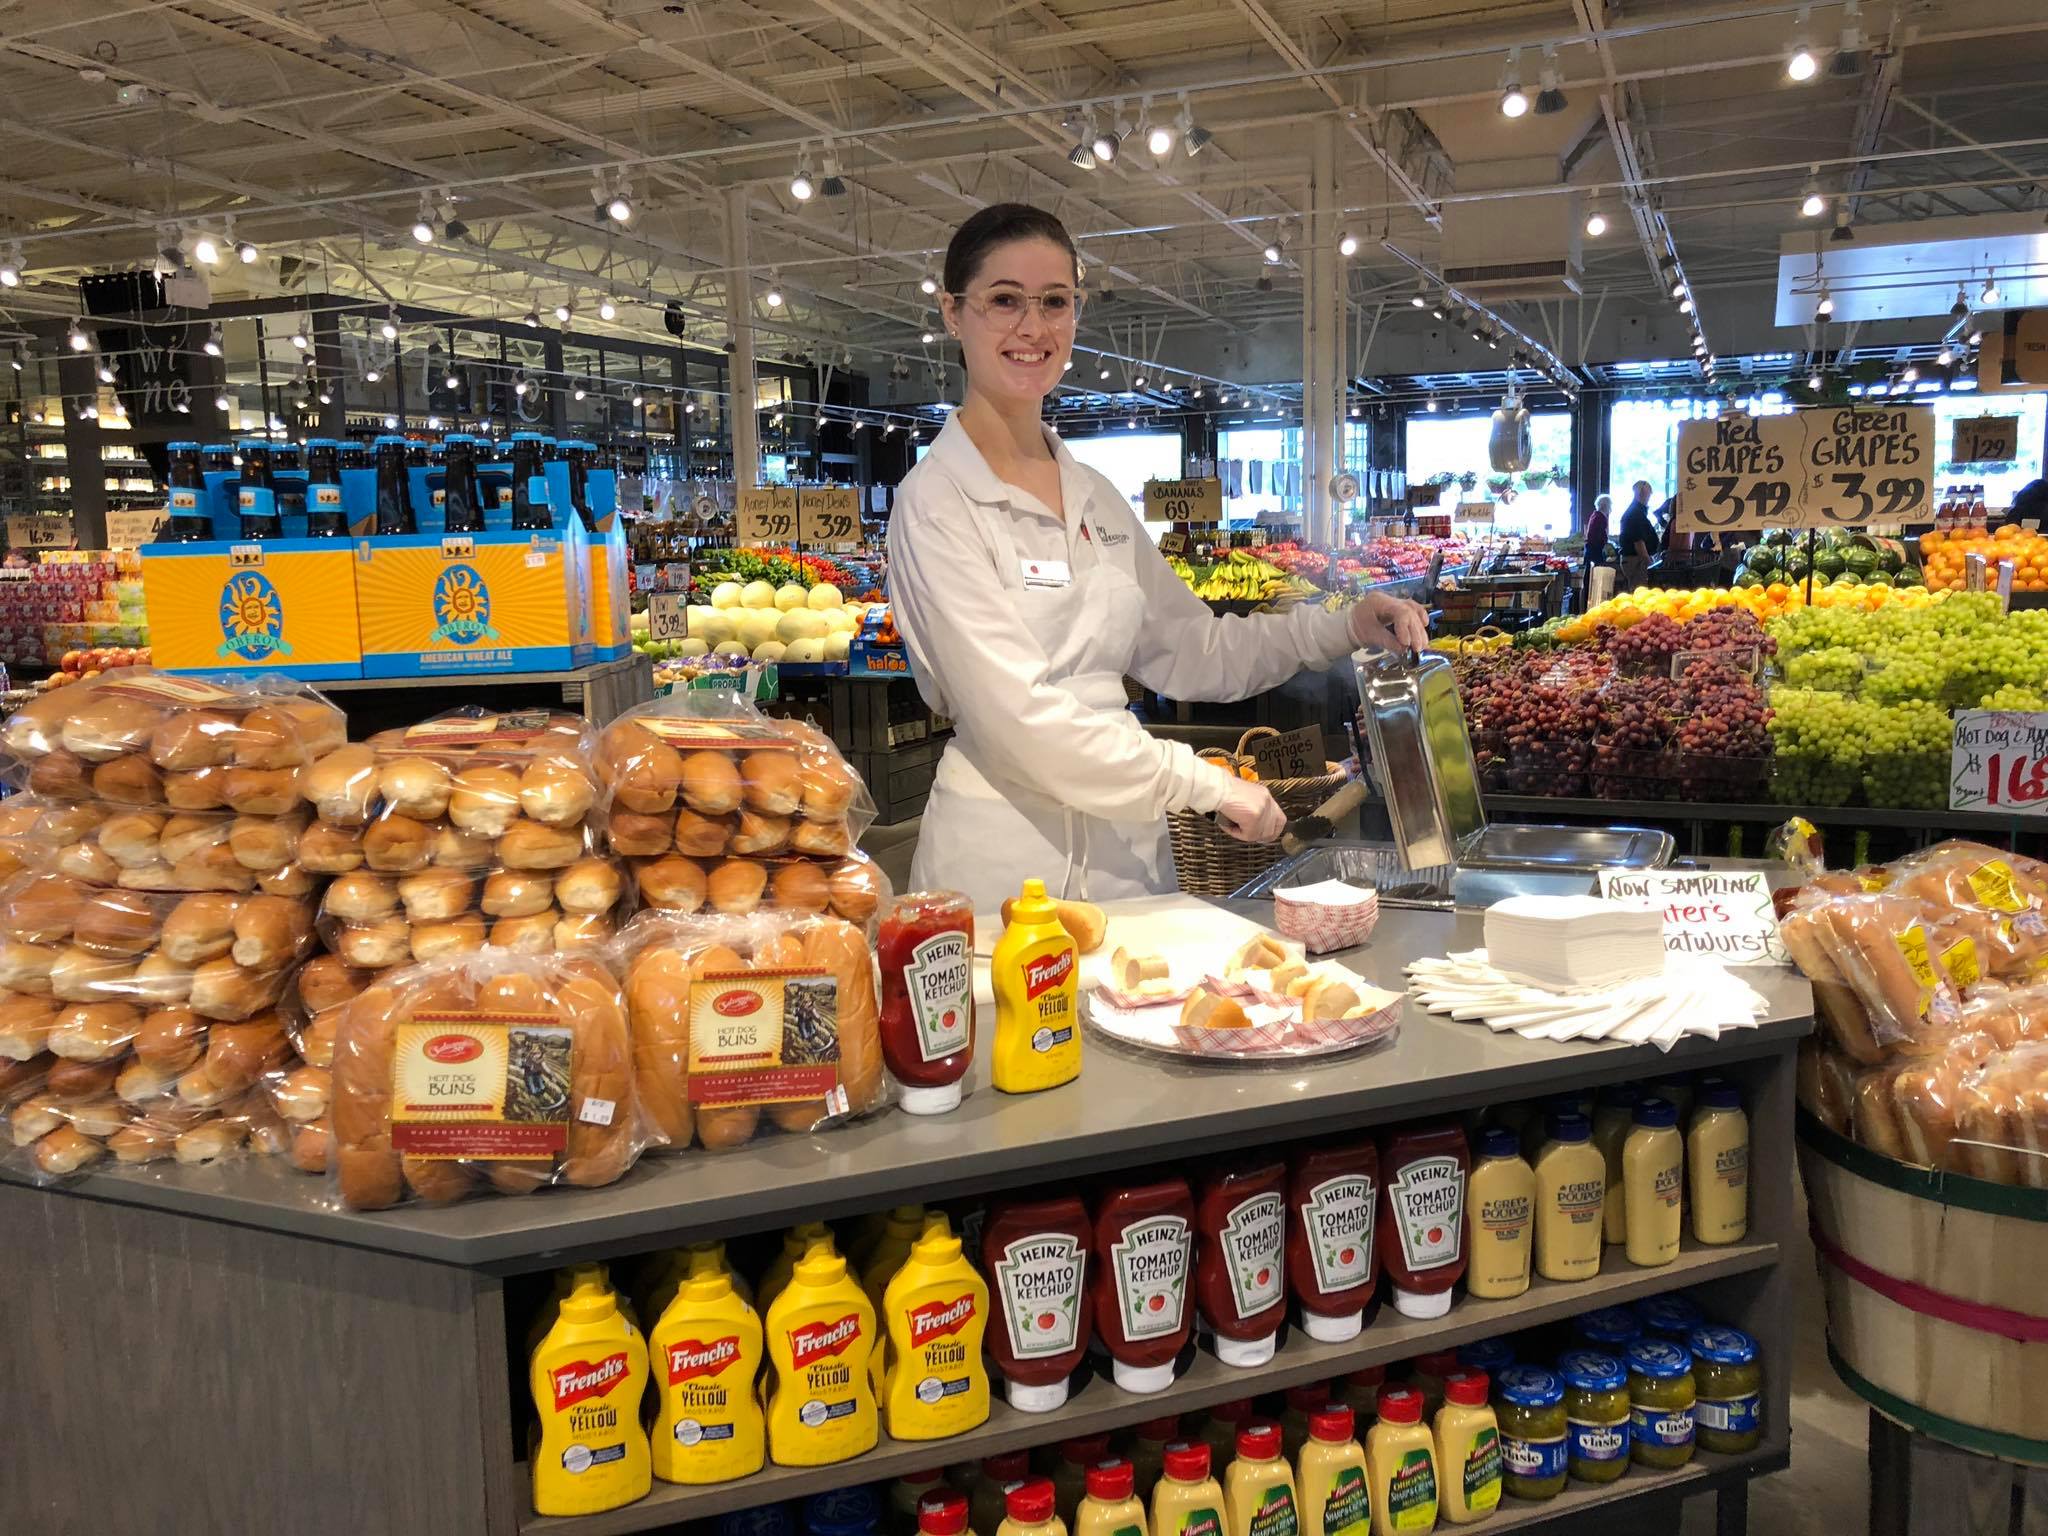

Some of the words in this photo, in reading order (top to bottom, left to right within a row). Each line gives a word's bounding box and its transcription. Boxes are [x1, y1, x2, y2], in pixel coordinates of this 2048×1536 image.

[1716, 416, 1761, 445] Red
[1832, 411, 1907, 435] Green
[1686, 444, 1784, 474] GRAPES
[1811, 433, 1920, 467] GRAPES
[1153, 486, 1205, 499] BANANAS
[437, 622, 490, 637] OBERON
[225, 633, 282, 651] OBERON
[420, 653, 464, 663] AMERICAN
[466, 652, 495, 662] WHEAT
[497, 651, 512, 660] ALE
[866, 655, 907, 672] halos
[1258, 739, 1313, 762] Oranges
[1608, 877, 1649, 899] NOW
[1661, 878, 1755, 898] SAMPLING
[926, 942, 961, 964] HEINZ
[920, 963, 967, 990] TOMATO
[1029, 952, 1073, 988] French's
[924, 979, 967, 1001] KETCHUP
[1038, 995, 1068, 1017] YELLOW
[737, 1025, 757, 1033] DOG
[718, 1034, 757, 1047] BUNS
[428, 1074, 449, 1082] HOT
[452, 1074, 476, 1082] DOG
[428, 1082, 476, 1096] BUNS
[1411, 1167, 1449, 1184] HEINZ
[1324, 1185, 1362, 1204] HEINZ
[1405, 1185, 1456, 1207] TOMATO
[1493, 1197, 1520, 1210] GREY
[1557, 1190, 1603, 1202] POUPON
[1241, 1203, 1273, 1226] HEINZ
[1318, 1204, 1368, 1227] TOMATO
[1409, 1200, 1456, 1217] KETCHUP
[1482, 1205, 1529, 1219] POUPON
[1136, 1228, 1177, 1247] HEINZ
[1235, 1221, 1280, 1251] TOMATO
[1322, 1220, 1367, 1238] KETCHUP
[1021, 1246, 1066, 1263] HEINZ
[1239, 1236, 1279, 1262] KETCHUP
[1128, 1249, 1182, 1271] TOMATO
[1013, 1266, 1074, 1288] TOMATO
[1131, 1264, 1181, 1283] KETCHUP
[1017, 1282, 1072, 1300] KETCHUP
[915, 1299, 971, 1335] French's
[795, 1318, 855, 1357] French's
[672, 1342, 734, 1373] French's
[924, 1346, 965, 1367] YELLOW
[558, 1358, 623, 1397] French's
[807, 1369, 850, 1388] YELLOW
[682, 1390, 726, 1407] YELLOW
[570, 1409, 617, 1433] YELLOW
